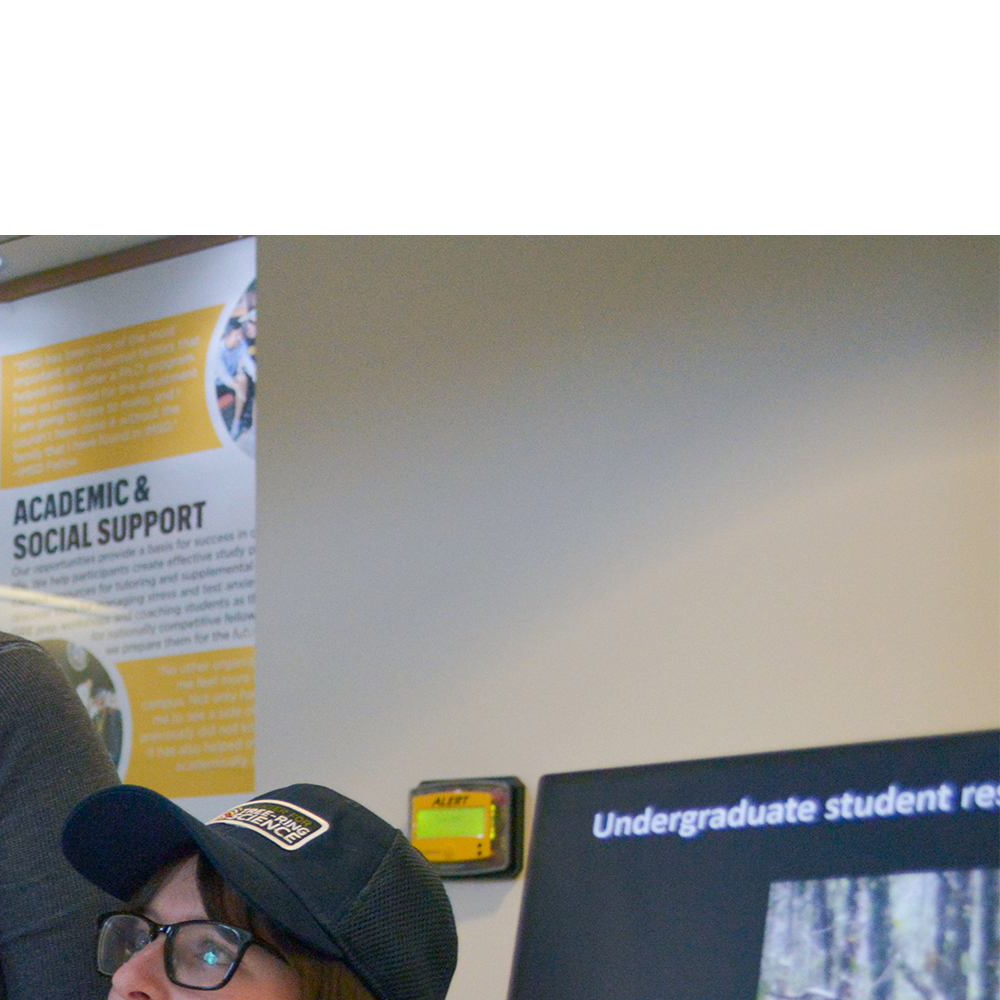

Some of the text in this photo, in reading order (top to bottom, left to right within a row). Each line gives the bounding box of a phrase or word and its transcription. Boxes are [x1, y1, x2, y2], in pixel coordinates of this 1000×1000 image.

[13, 475, 150, 526] ACADEMIC &
[13, 501, 207, 560] SOCIAL SUPPORT
[592, 796, 817, 839] Undergraduate
[824, 783, 952, 821] student
